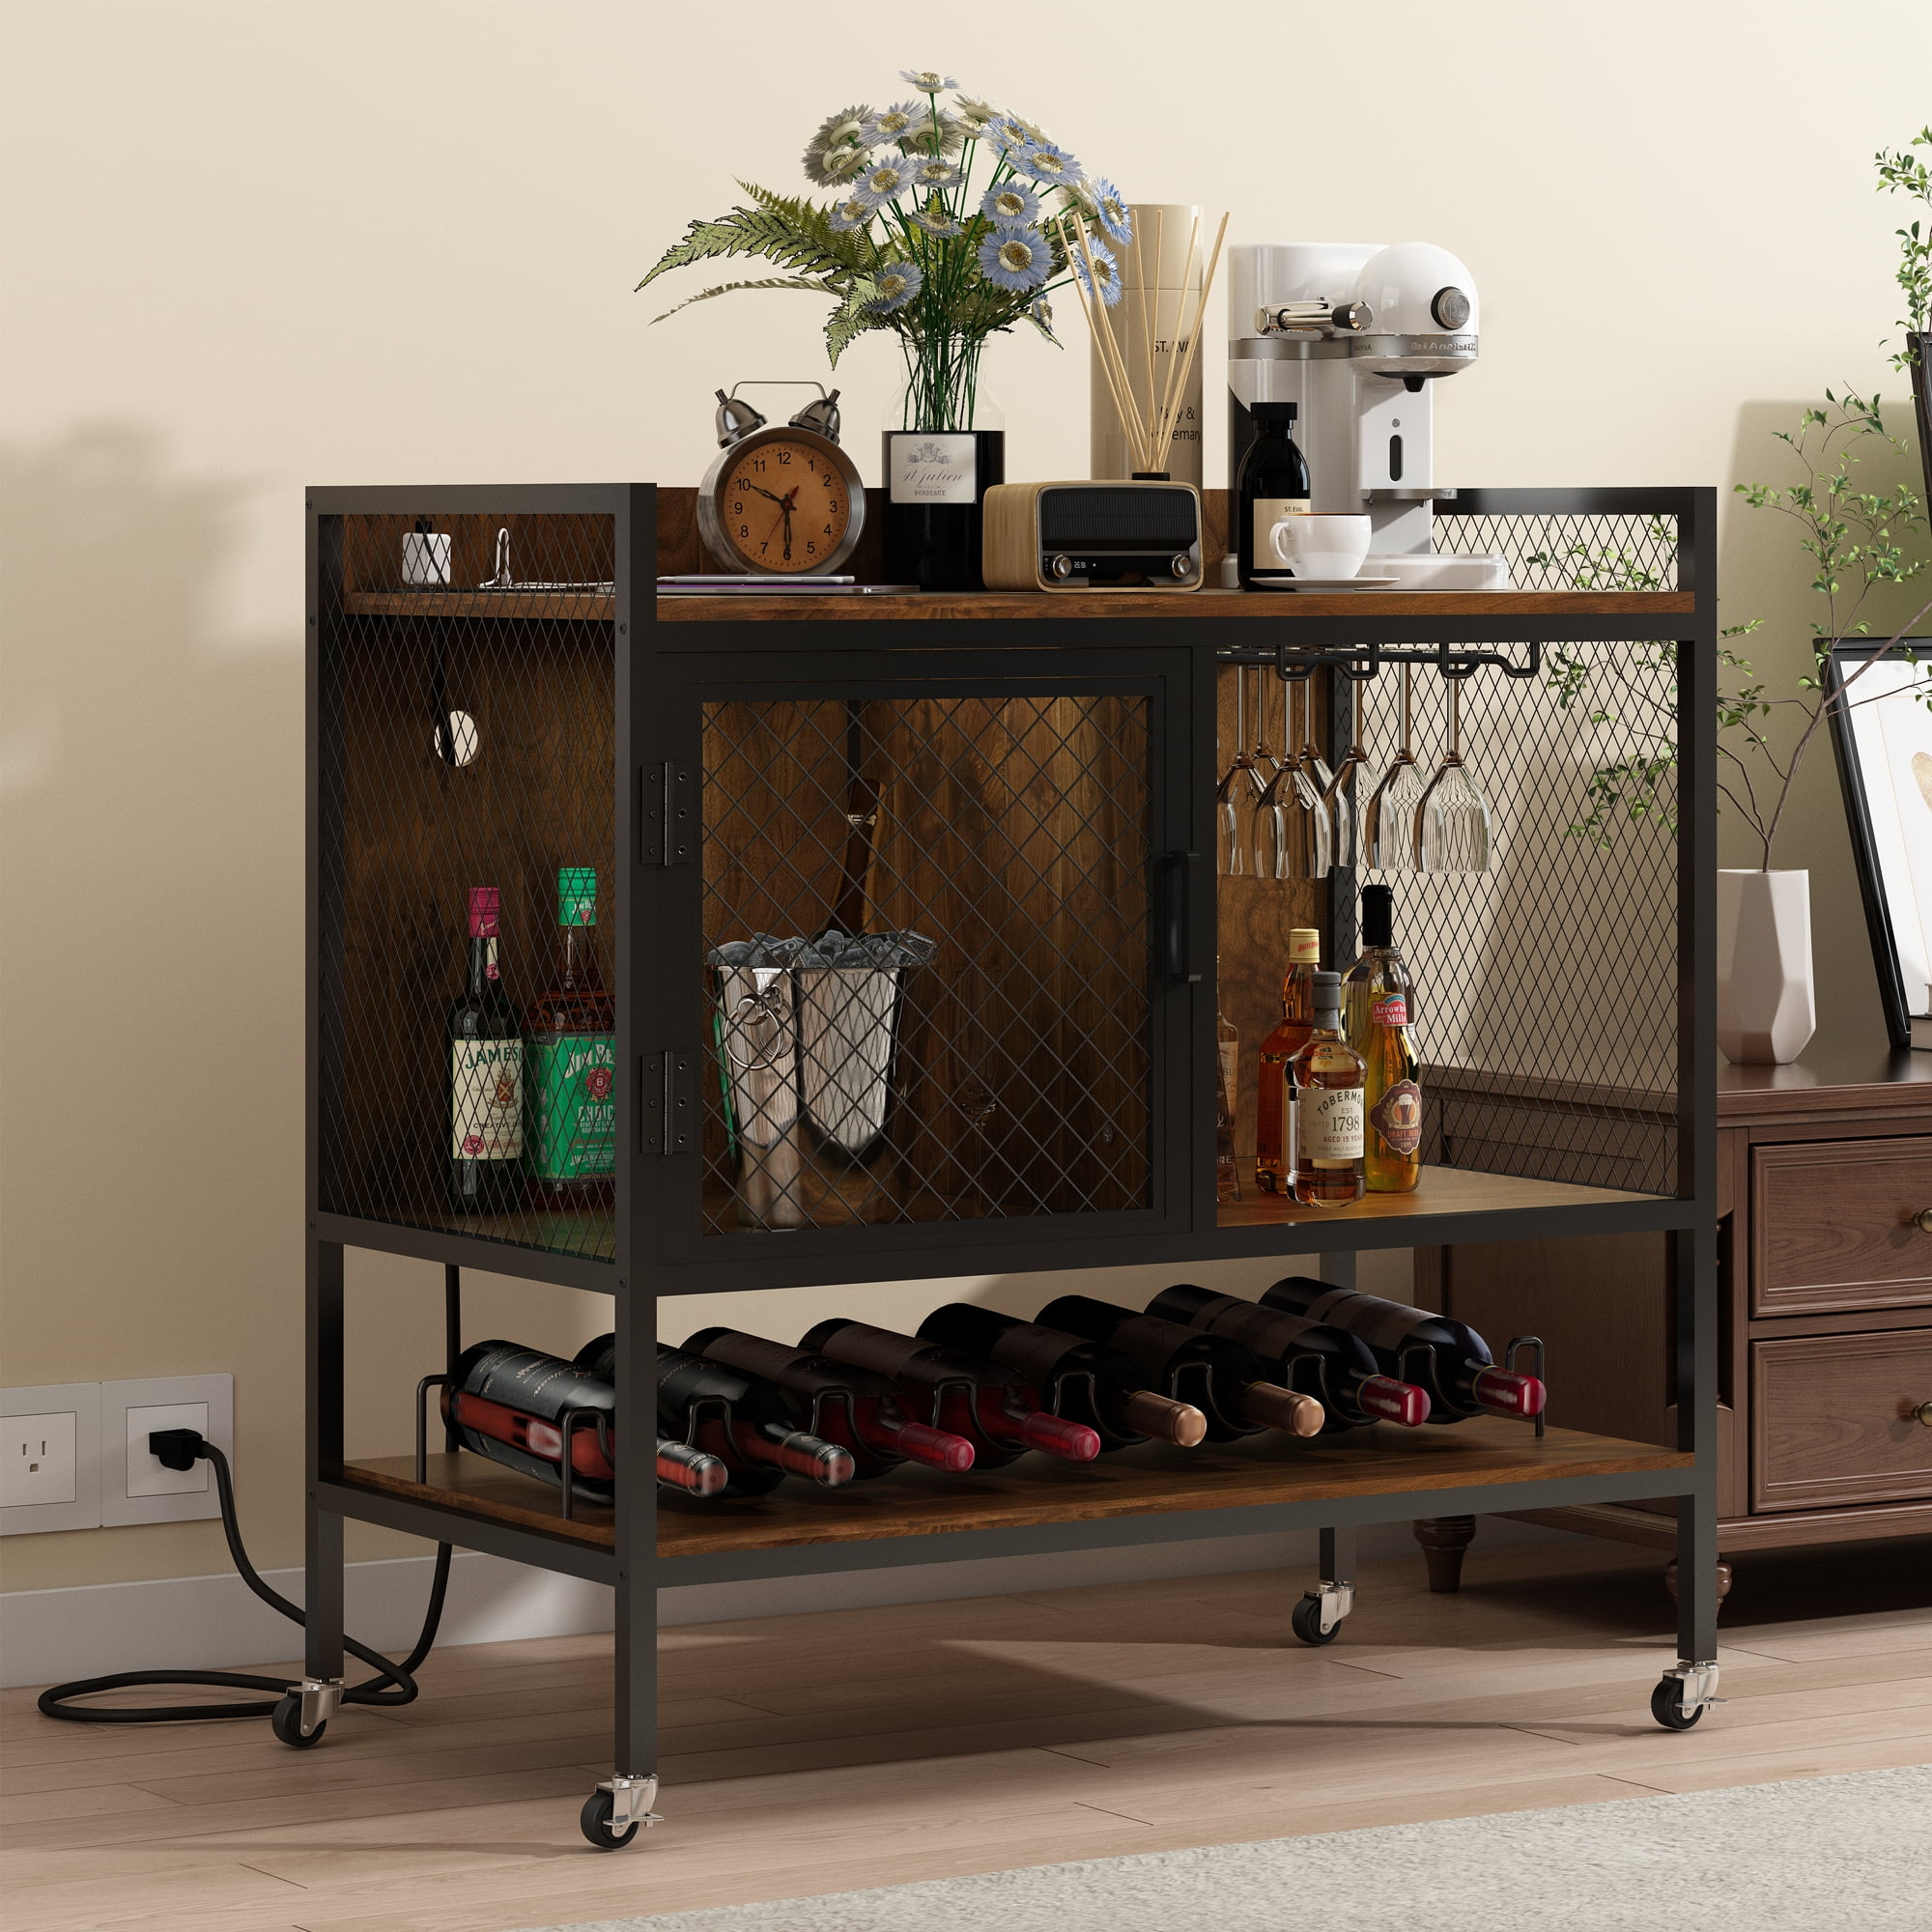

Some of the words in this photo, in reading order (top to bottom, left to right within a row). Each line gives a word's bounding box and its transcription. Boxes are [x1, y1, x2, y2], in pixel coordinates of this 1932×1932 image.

[1186, 407, 1195, 419] &
[777, 452, 791, 464] 12
[753, 460, 765, 471] 11
[808, 460, 814, 471] 1
[737, 478, 751, 491] 10
[823, 474, 832, 487] 2
[734, 502, 743, 514] 9
[830, 500, 838, 513] 3
[740, 526, 749, 537] 8
[823, 524, 832, 535] 4
[760, 542, 768, 554] 7
[807, 541, 815, 554] 5
[783, 548, 791, 560] 6
[595, 1043, 615, 1065] BE
[596, 1077, 604, 1087] B
[578, 1104, 613, 1122] CHOIC
[1331, 1115, 1360, 1132] 1798
